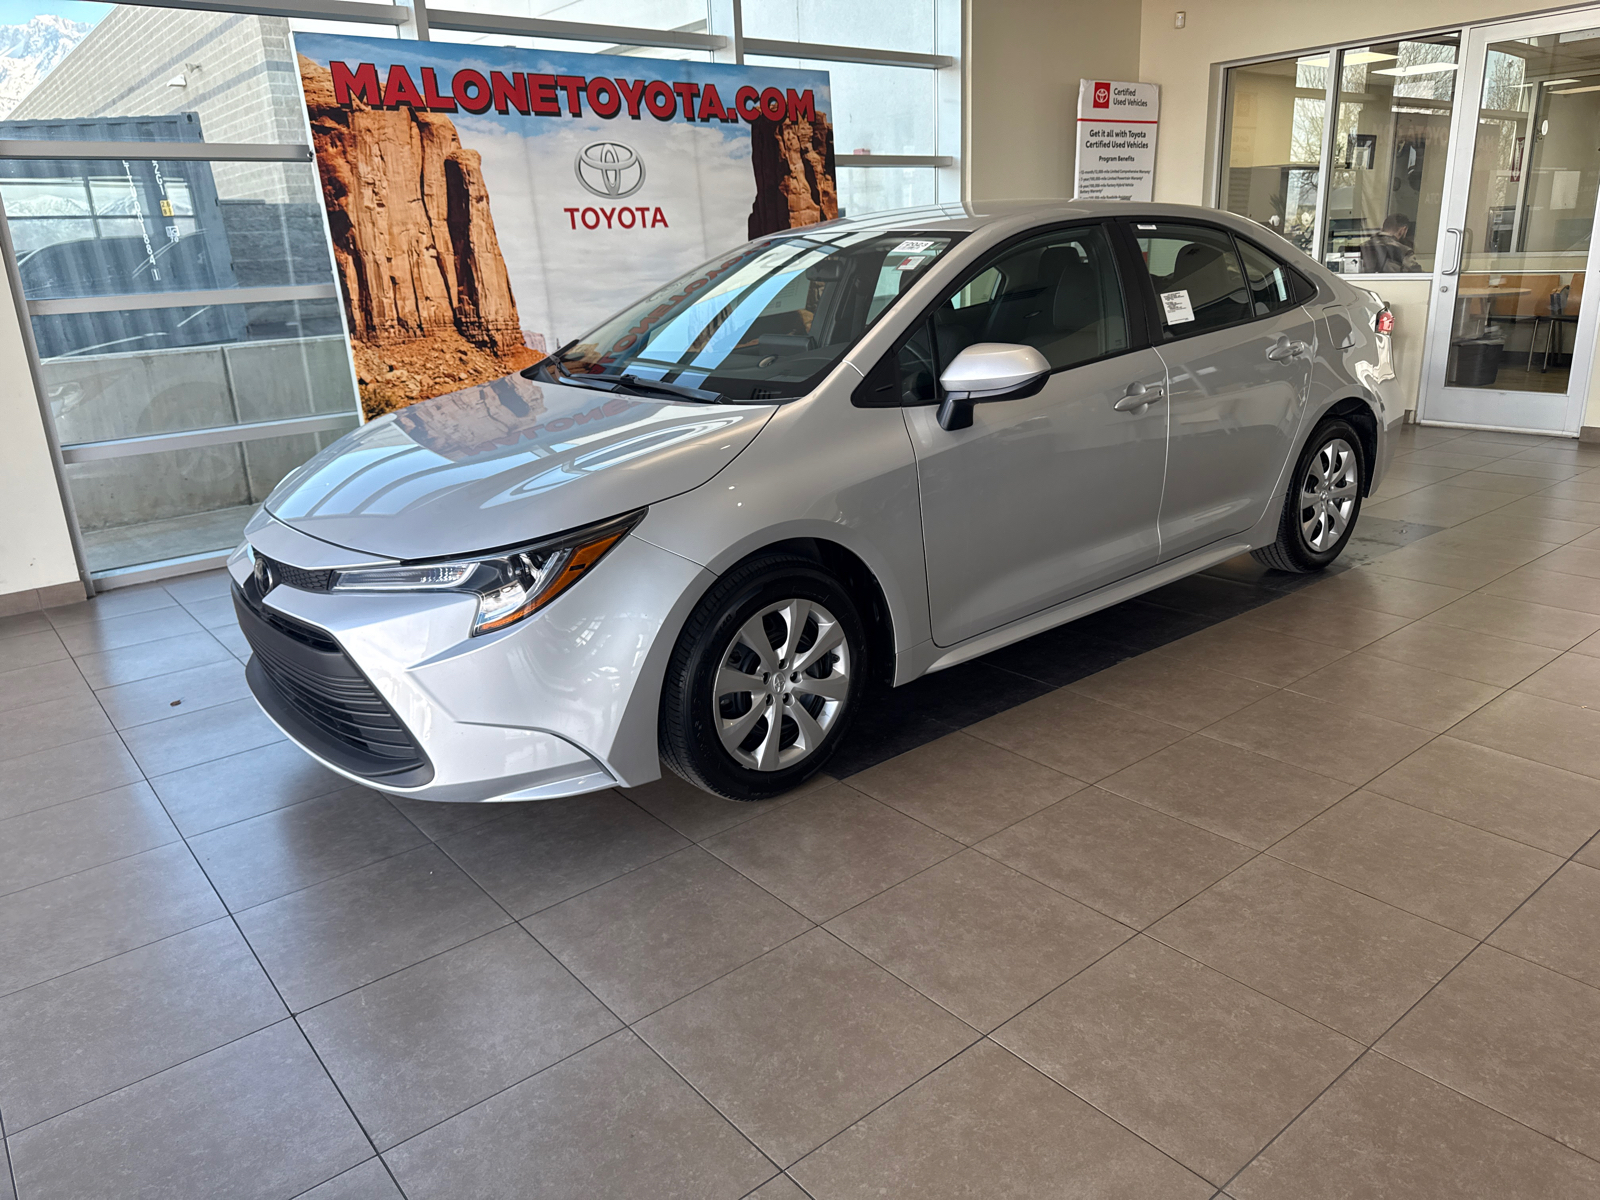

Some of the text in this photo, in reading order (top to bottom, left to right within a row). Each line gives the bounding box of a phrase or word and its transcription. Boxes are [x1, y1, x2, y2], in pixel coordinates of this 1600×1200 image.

[329, 61, 816, 123] MALONETOYOTA.COM
[1113, 88, 1136, 96] Certified
[1113, 98, 1148, 107] Used Vehicles
[1089, 129, 1146, 140] Get it all with Toyota
[1085, 140, 1149, 149] Certified Used Vehicles
[1098, 155, 1118, 164] Program
[564, 206, 669, 230] TOYOTA
